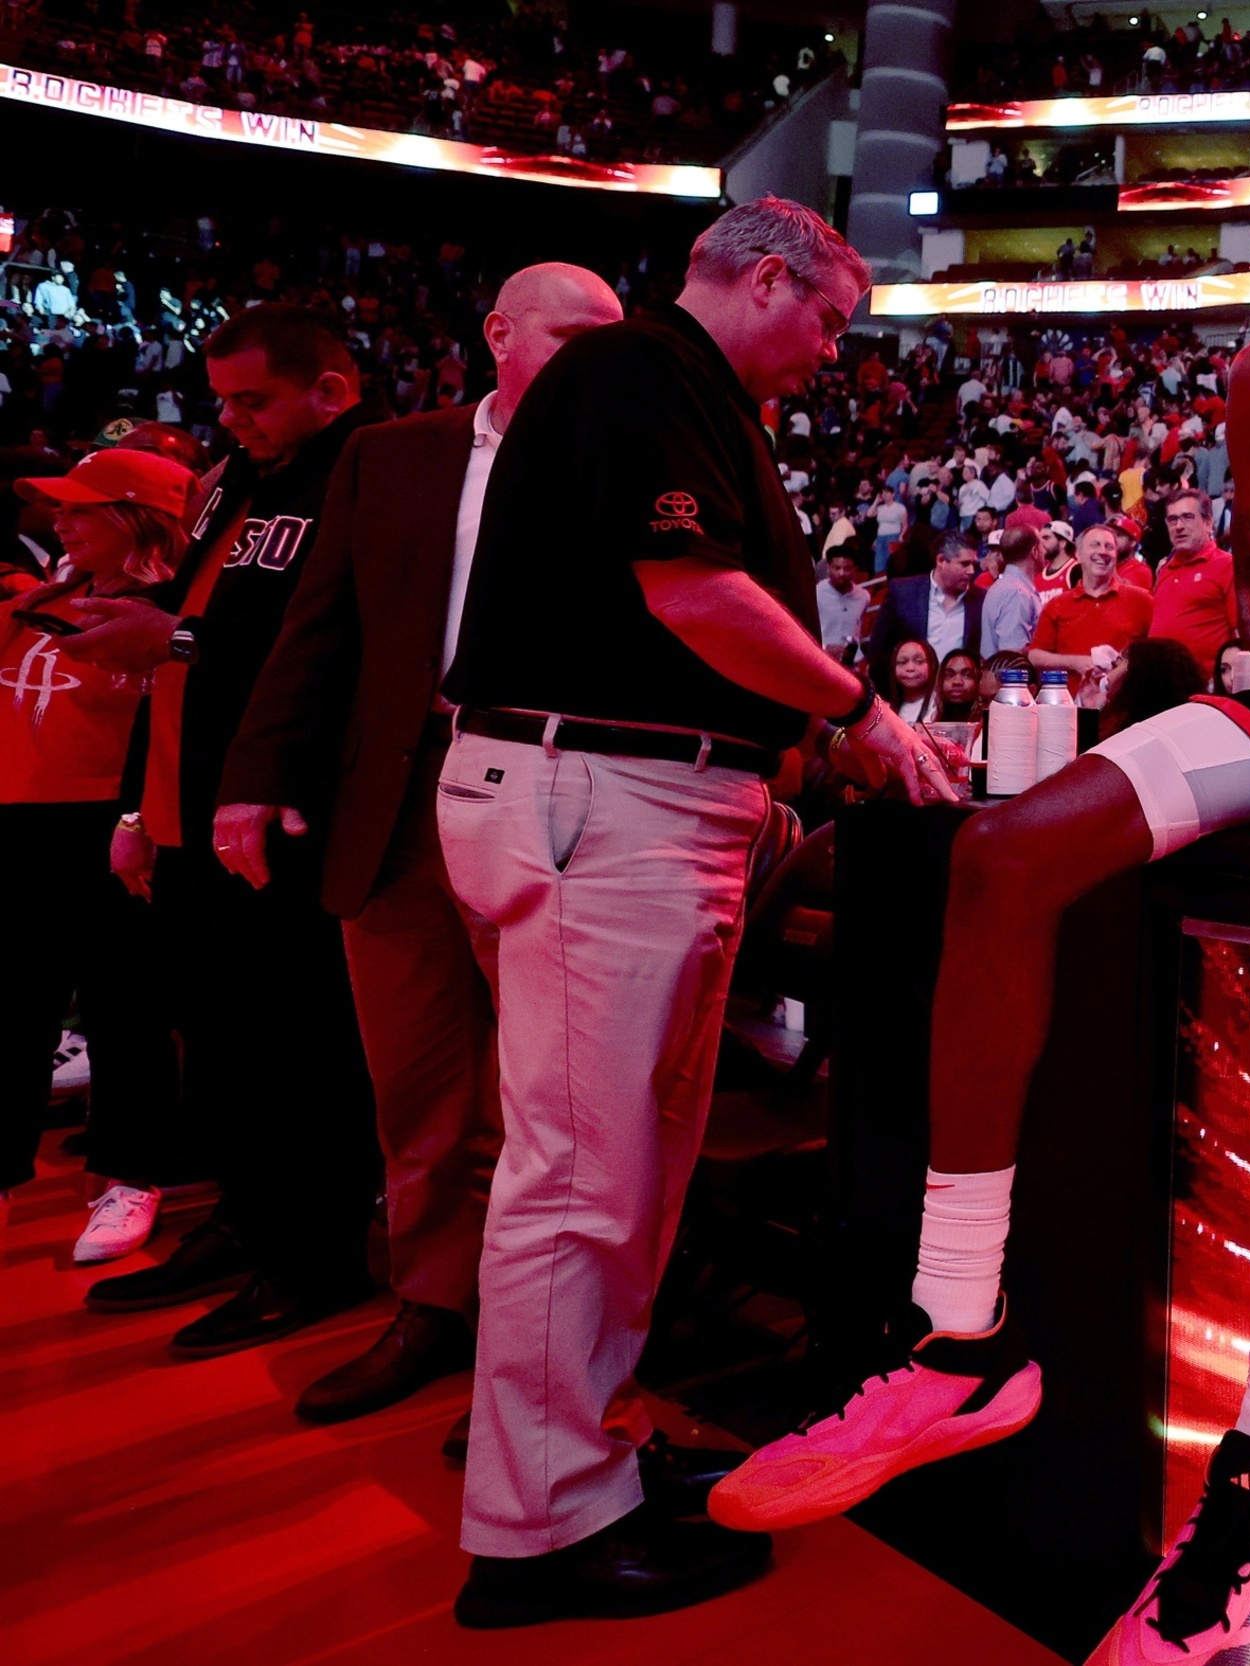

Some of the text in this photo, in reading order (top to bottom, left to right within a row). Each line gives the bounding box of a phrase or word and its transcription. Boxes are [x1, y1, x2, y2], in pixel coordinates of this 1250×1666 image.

[9, 67, 321, 146] ROCKETS WIN
[982, 281, 1201, 313] ROCKETS WIN
